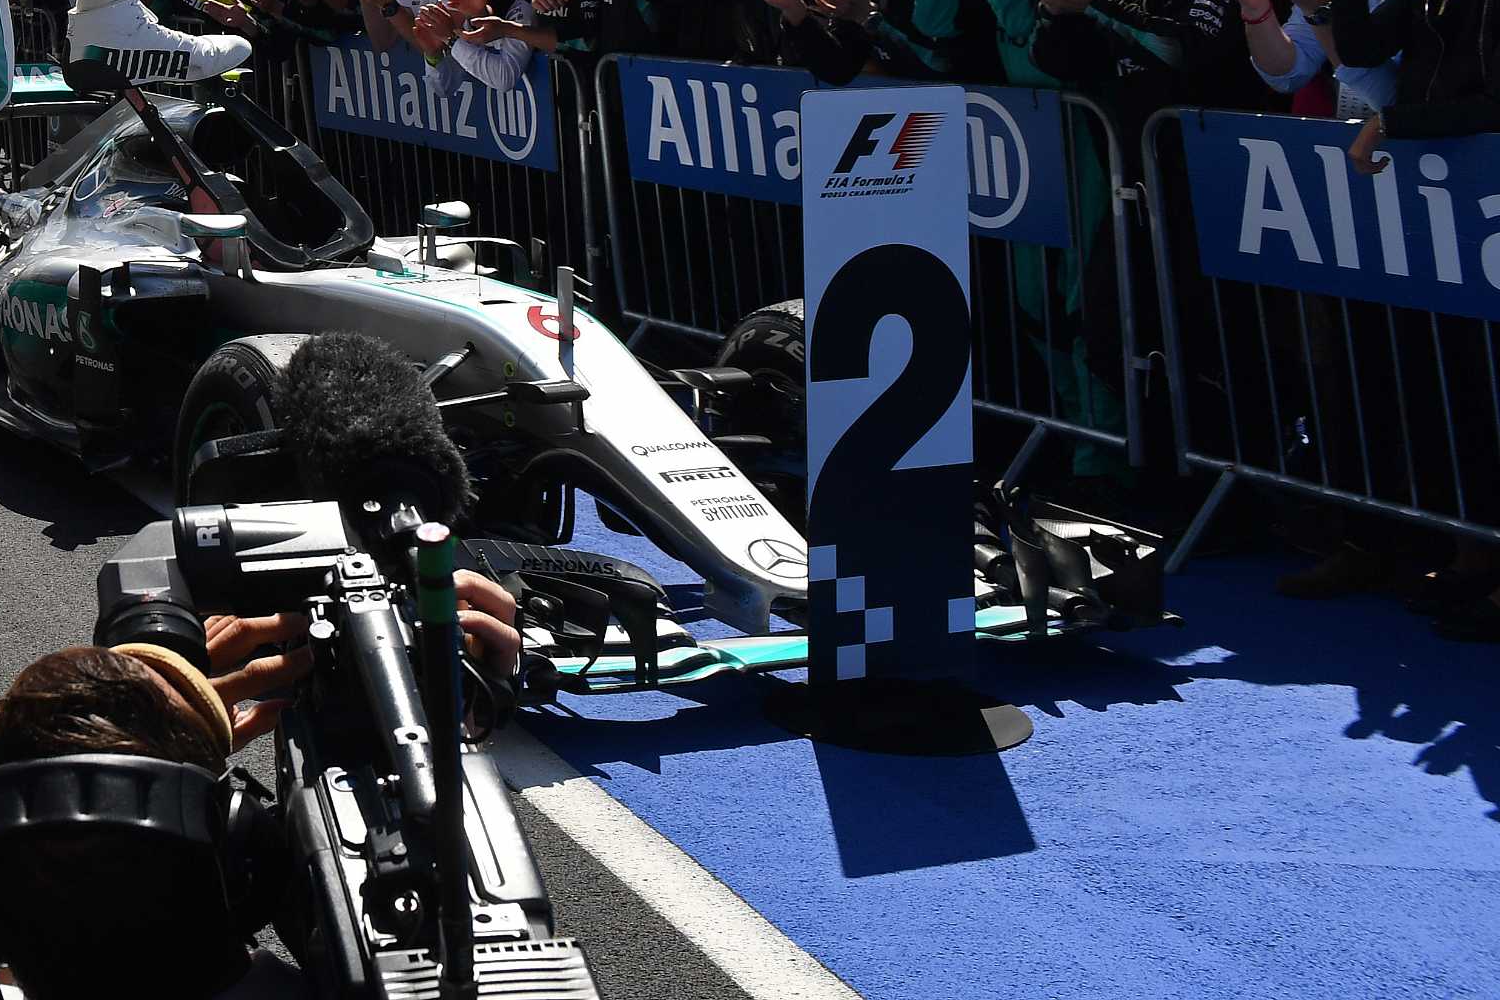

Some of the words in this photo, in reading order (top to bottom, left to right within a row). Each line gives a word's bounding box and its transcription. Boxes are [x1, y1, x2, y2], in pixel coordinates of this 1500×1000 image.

[646, 74, 801, 181] Allia
[833, 112, 948, 174] F1
[825, 176, 850, 189] FIA
[851, 174, 905, 188] Formula
[905, 173, 916, 185] 1
[526, 305, 581, 341] 6
[763, 329, 804, 362] ZE
[75, 354, 115, 372] PETRONAS
[807, 243, 973, 540] 2
[659, 465, 737, 484] PIRELLI
[690, 494, 756, 506] PETRONAS
[701, 502, 768, 522] SYNTIUM
[522, 558, 615, 575] PETRONAS
